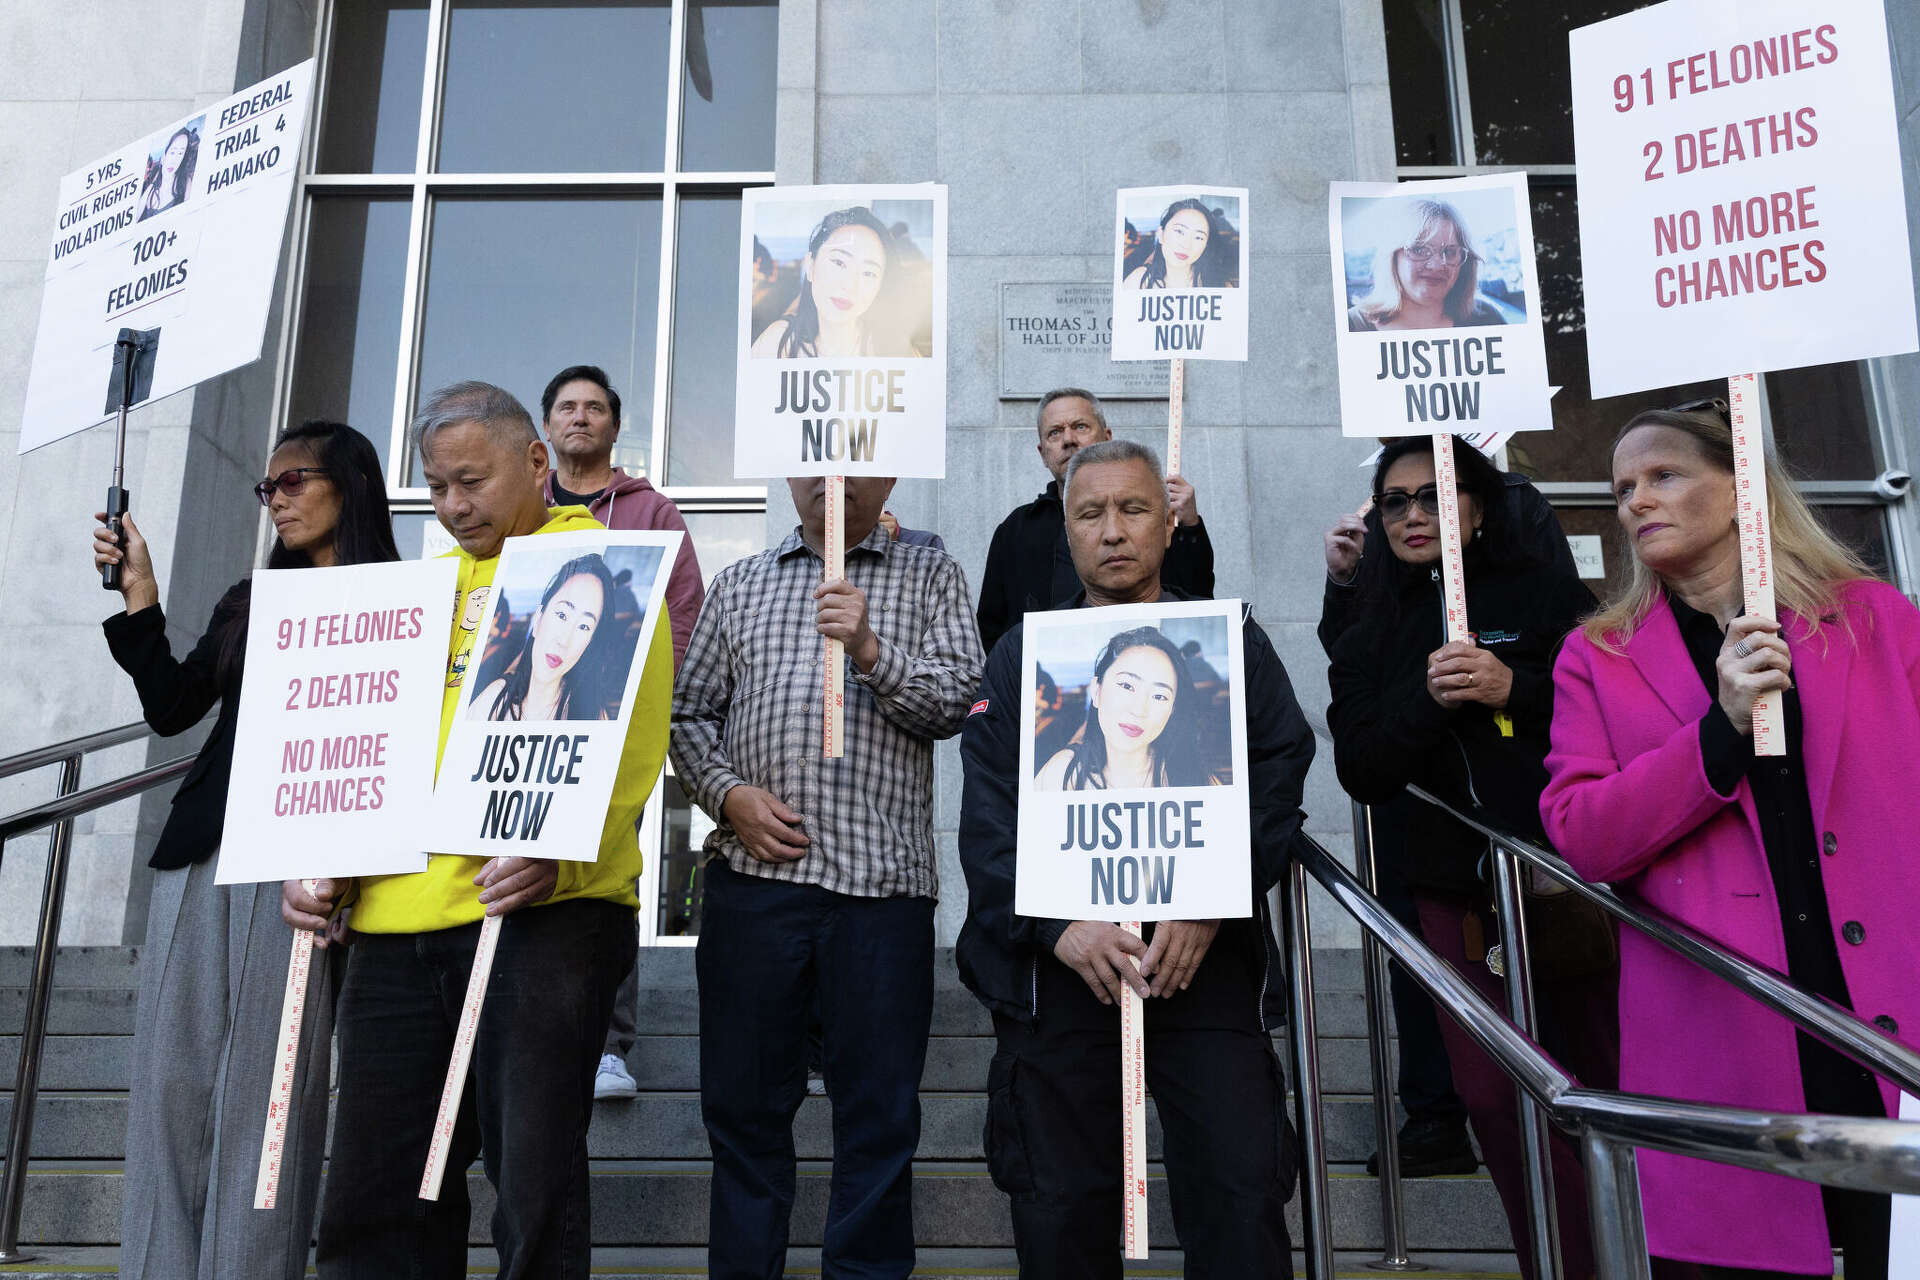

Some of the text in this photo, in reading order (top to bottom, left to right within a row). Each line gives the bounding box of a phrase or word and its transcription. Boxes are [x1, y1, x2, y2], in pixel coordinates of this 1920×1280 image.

[1613, 24, 1839, 113] 91 FELONIES
[219, 80, 292, 130] FEDERAL
[215, 113, 286, 161] TRIAL 4
[1643, 106, 1818, 182] 2 DEATHS
[86, 158, 122, 190] 5 YRS
[207, 145, 280, 195] HANAKO
[59, 177, 139, 230] CIVIL RIGHTS
[1653, 185, 1820, 257] NO MORE
[54, 206, 134, 261] VIOLATIONS
[132, 230, 177, 266] 100+
[106, 258, 188, 314] FELONIES
[1655, 239, 1827, 308] CHANCES
[1006, 317, 1081, 331] THOMAS
[1138, 294, 1222, 323] JUSTICE
[1023, 333, 1062, 345] HALL
[1067, 333, 1087, 345] OF
[1154, 324, 1205, 351] NOW
[1376, 336, 1505, 380] JUSTICE
[775, 369, 905, 414] JUSTICE
[1405, 381, 1480, 423] NOW
[801, 418, 878, 462] NOW
[1756, 537, 1766, 569] helpful
[1759, 571, 1768, 588] The
[277, 607, 423, 650] 91 FELONIES
[1448, 607, 1456, 622] ACE
[286, 669, 400, 710] 2 DEATHS
[281, 732, 389, 774] NO MORE
[471, 734, 589, 784] JUSTICE
[274, 775, 385, 817] CHANCES
[480, 789, 554, 841] NOW
[1060, 800, 1205, 851] JUSTICE
[1091, 855, 1176, 905] NOW
[269, 1101, 278, 1119] ACE
[1137, 1179, 1145, 1198] ACE
